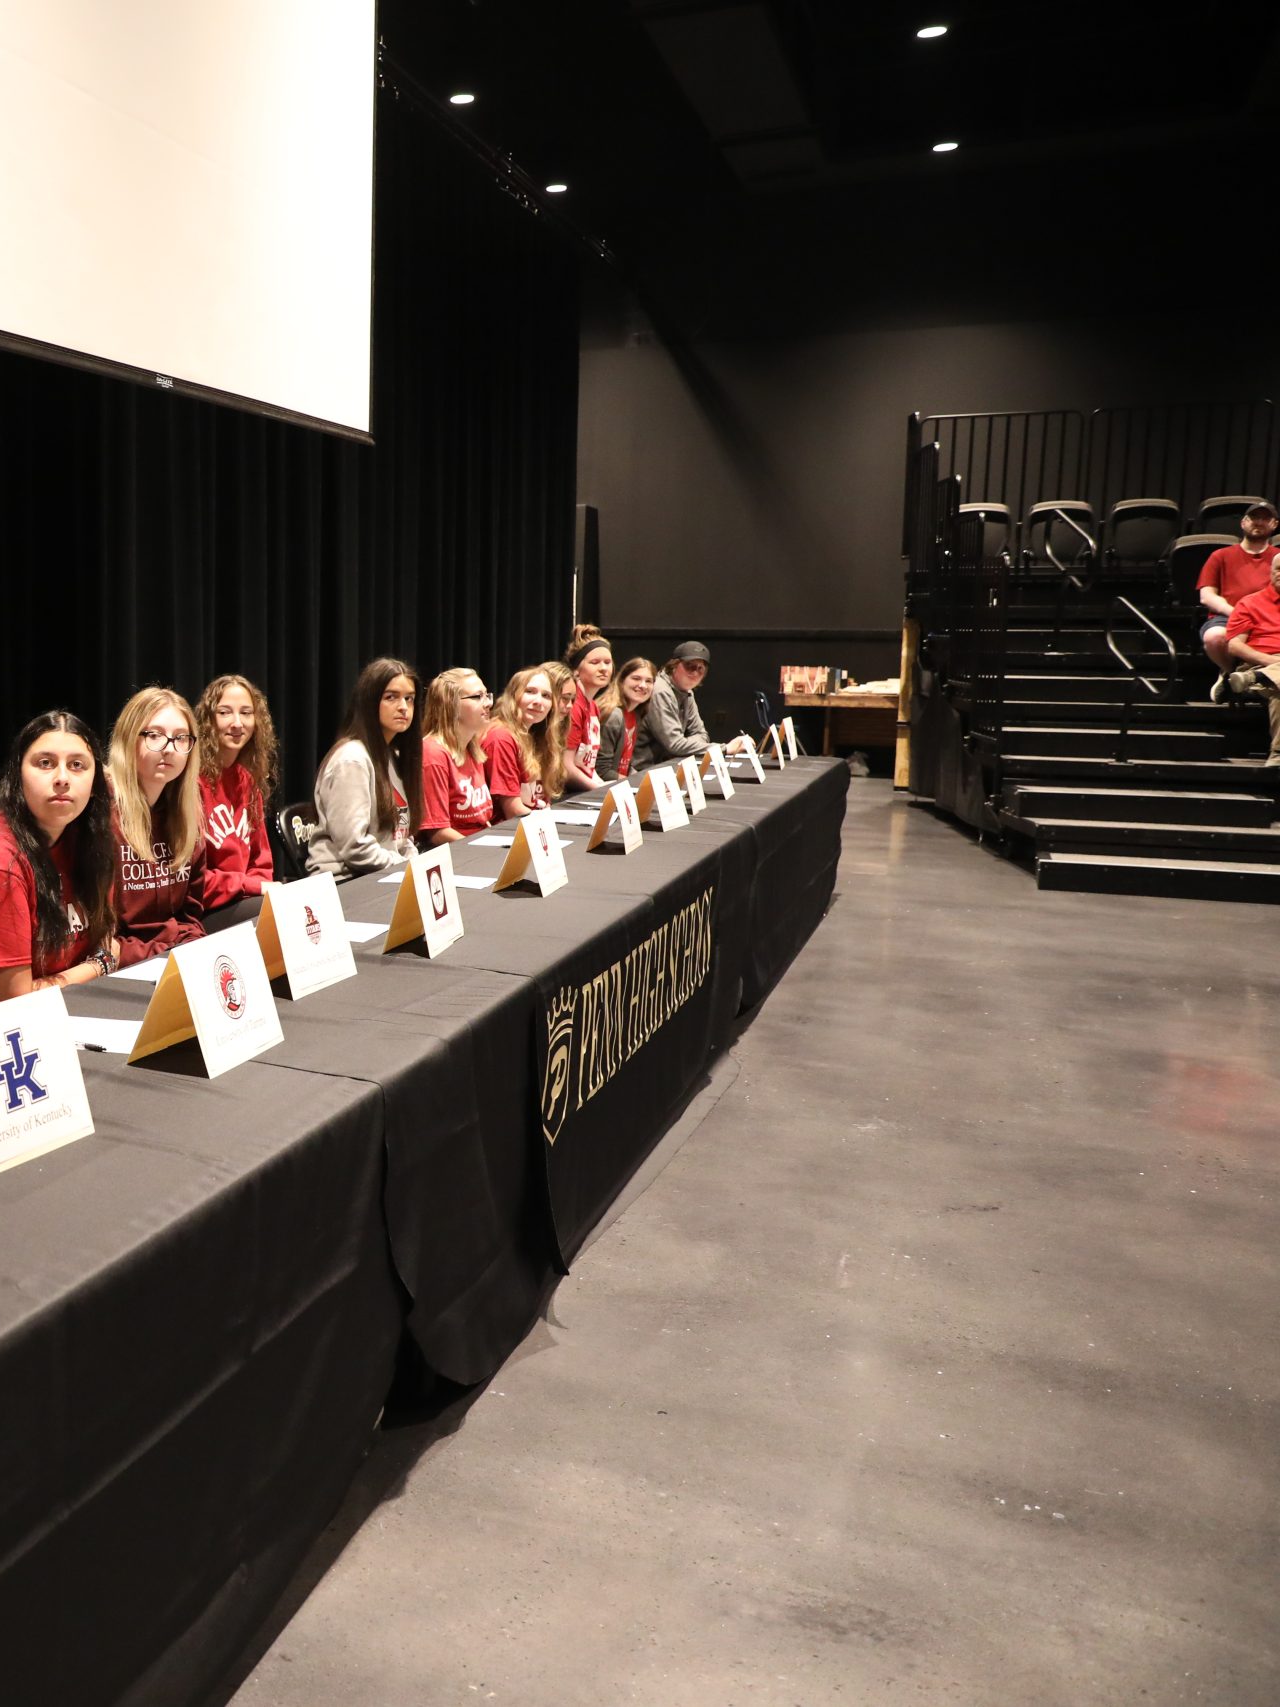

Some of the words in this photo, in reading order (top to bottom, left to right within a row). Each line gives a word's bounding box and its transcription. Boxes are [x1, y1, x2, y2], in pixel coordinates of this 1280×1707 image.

[127, 882, 144, 891] Notre
[576, 954, 630, 1111] PENN
[626, 922, 669, 1062] HIGH
[23, 1116, 33, 1132] of
[34, 1103, 72, 1128] Kentucky
